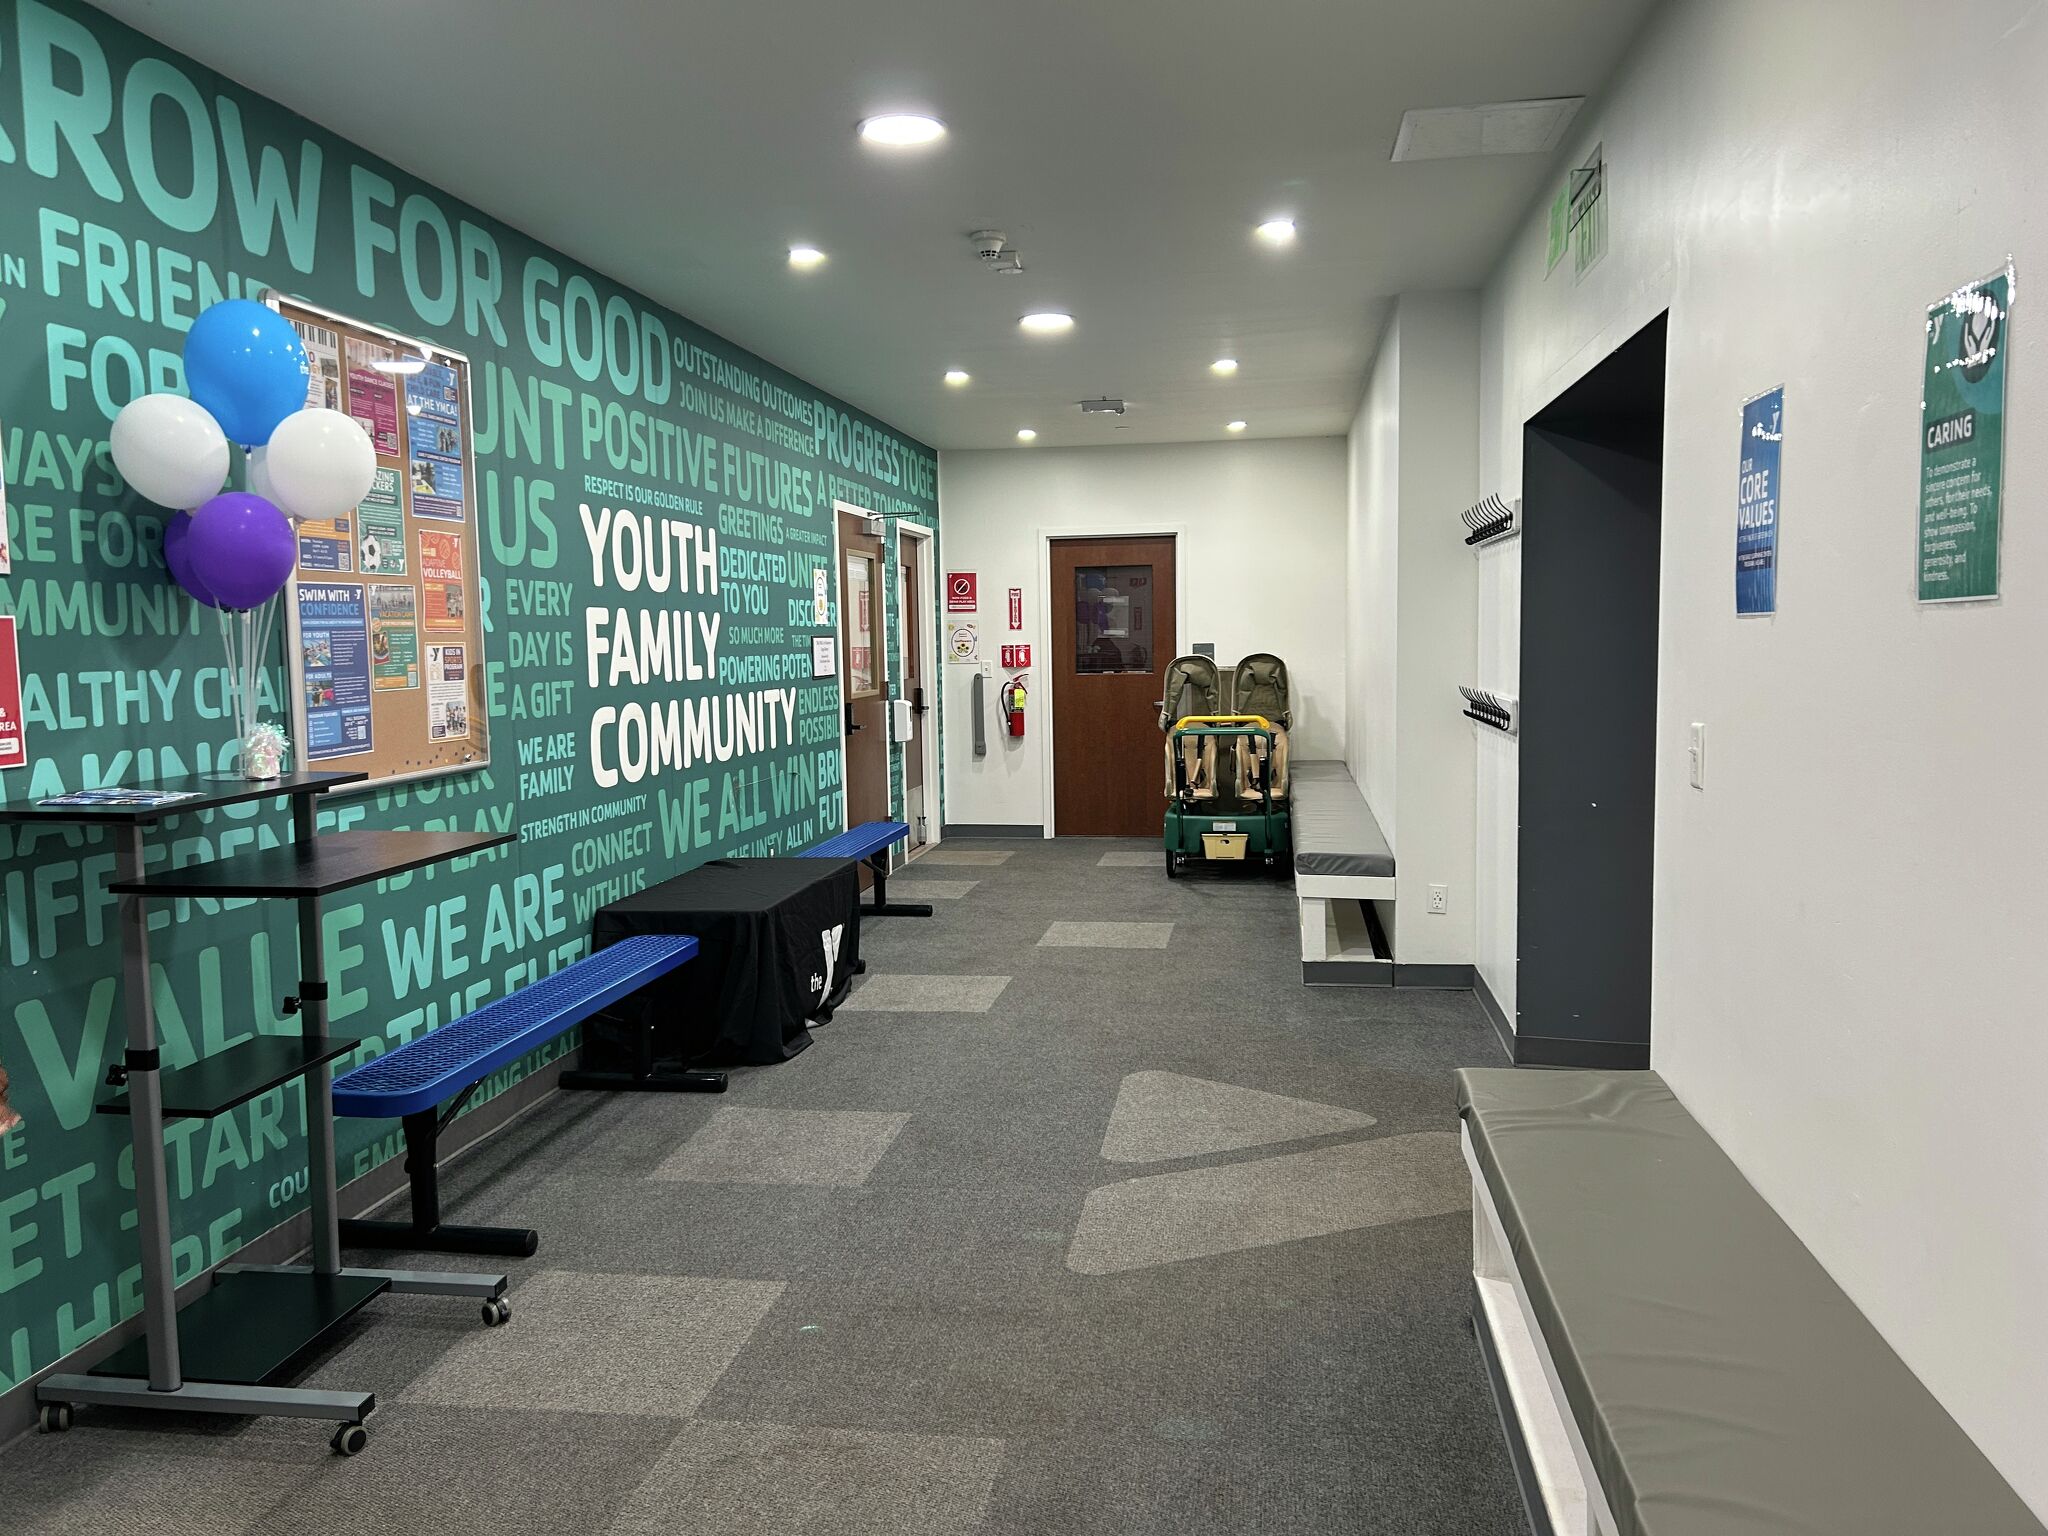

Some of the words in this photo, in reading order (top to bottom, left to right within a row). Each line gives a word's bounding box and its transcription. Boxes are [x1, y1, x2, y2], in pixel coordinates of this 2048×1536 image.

[0, 0, 323, 273] ROW
[351, 164, 507, 348] FOR
[522, 256, 671, 405] GOOD
[674, 337, 760, 403] OUTSTANDING
[762, 380, 813, 427] OUTCOMES
[407, 394, 417, 406] AT
[419, 396, 435, 410] THE
[435, 400, 457, 416] YMCA!
[680, 381, 707, 414] JOIN
[708, 390, 724, 424] US
[726, 404, 755, 435] MAKE
[757, 418, 764, 438] A
[765, 418, 814, 458] DIFFERENCE
[814, 400, 899, 487] PROGRESS
[1927, 414, 1973, 448] CARING
[581, 393, 718, 493] POSITIVE
[723, 442, 812, 517] FUTURES
[1742, 458, 1752, 473] OUR
[584, 474, 623, 499] RESPECT
[625, 485, 633, 501] IS
[635, 486, 652, 504] OUR
[654, 490, 685, 511] GOLDEN
[685, 497, 703, 515] RULE
[817, 470, 827, 507] A
[1741, 470, 1769, 504] CORE
[486, 470, 558, 568] US
[718, 503, 783, 545] GREETINGS
[1739, 499, 1774, 530] VALUES
[69, 508, 165, 569] FOR
[579, 503, 718, 595] YOUTH
[423, 567, 461, 580] VOLLEYBALL
[720, 546, 786, 584] DEDICATED
[299, 588, 326, 601] SWIM
[327, 589, 350, 602] WITH
[300, 603, 360, 616] CONFIDENCE
[506, 579, 573, 616] EVERY
[721, 583, 739, 614] TO
[741, 584, 769, 615] YOU
[508, 632, 550, 668] DAY
[555, 631, 573, 666] IS
[586, 607, 720, 688] FAMILY
[729, 626, 740, 645] SO
[741, 627, 763, 644] MUCH
[764, 627, 784, 644] MORE
[719, 655, 780, 685] POWERING
[194, 665, 287, 720] CHA
[511, 684, 527, 720] A
[530, 680, 574, 719] GIFT
[799, 685, 839, 715] ENDLESS
[518, 738, 542, 766] WE
[546, 732, 576, 759] ARE
[590, 687, 797, 788] COMMUNITY
[519, 765, 574, 800] FAMILY
[521, 809, 577, 844] STRENGTH
[578, 807, 589, 828] IN
[591, 794, 647, 824] COMMUNITY
[658, 777, 711, 859] WE
[719, 765, 766, 840] ALL
[770, 750, 816, 820] WIN
[572, 822, 653, 878] CONNECT
[787, 825, 802, 851] ALL
[802, 819, 813, 844] IN
[381, 895, 469, 999] WE
[480, 863, 566, 964] ARE
[810, 972, 822, 993] the
